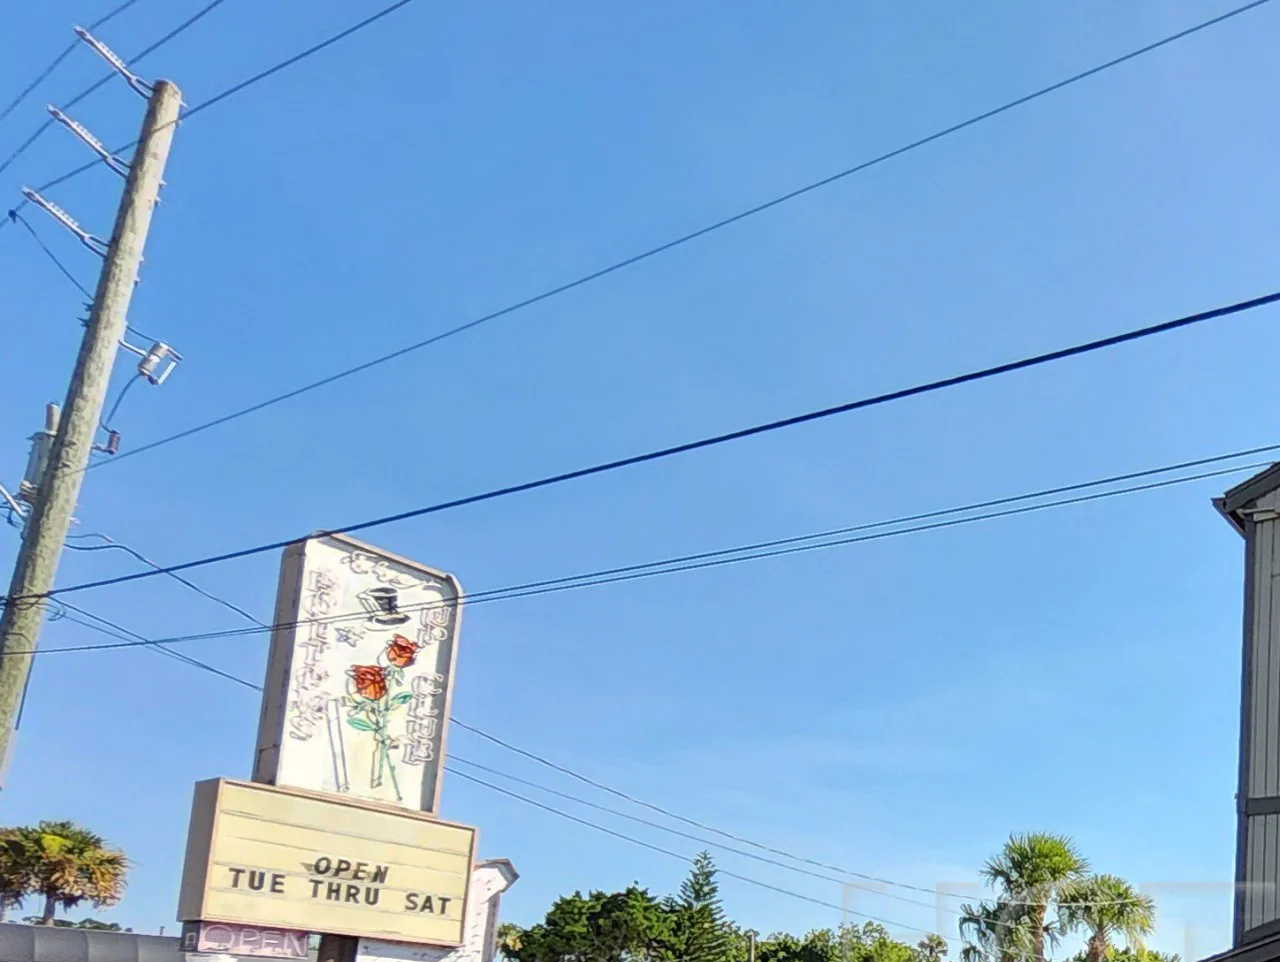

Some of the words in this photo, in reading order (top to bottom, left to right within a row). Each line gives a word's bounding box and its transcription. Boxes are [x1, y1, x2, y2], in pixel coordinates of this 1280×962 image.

[313, 857, 389, 884] OPEN
[228, 867, 285, 894] TUE
[309, 879, 380, 906] THRU
[404, 893, 451, 915] SAT
[202, 925, 307, 957] OPEN
